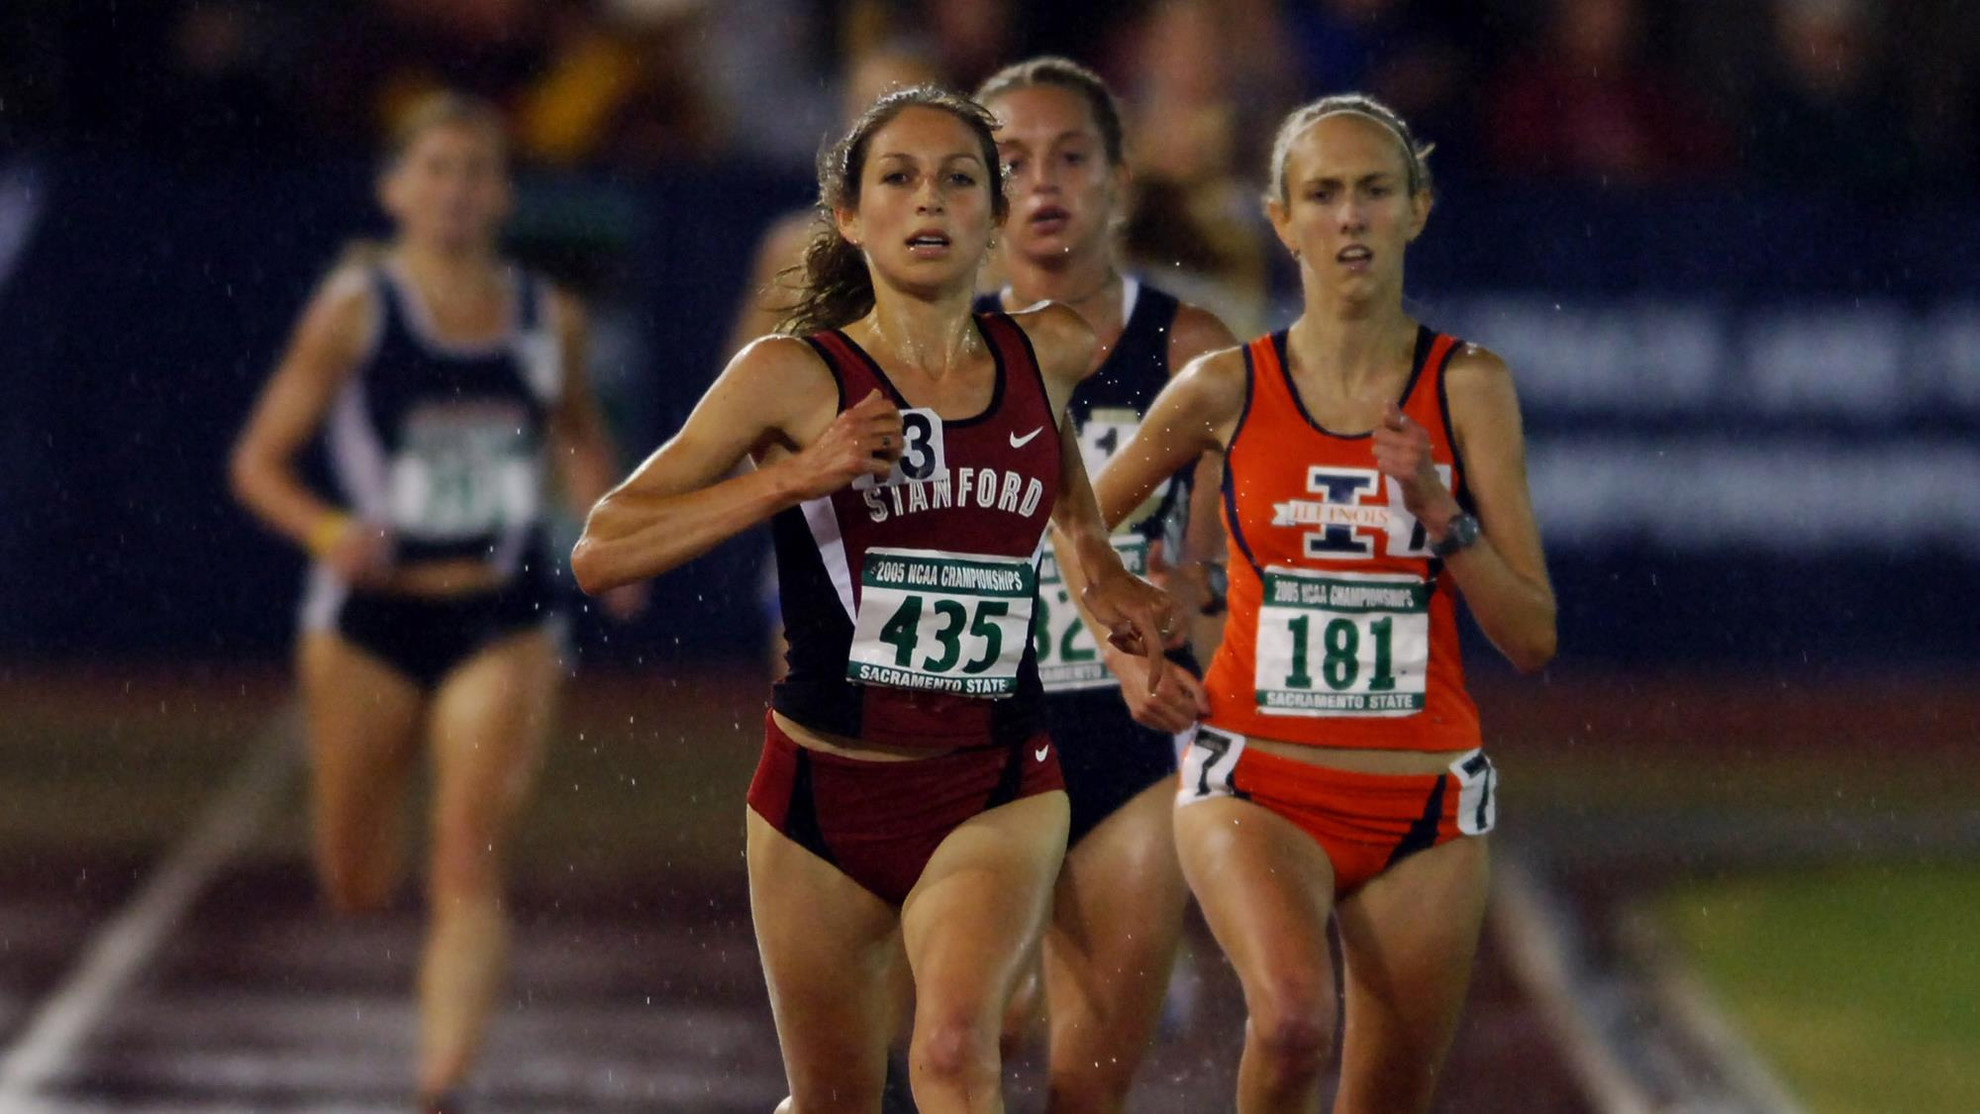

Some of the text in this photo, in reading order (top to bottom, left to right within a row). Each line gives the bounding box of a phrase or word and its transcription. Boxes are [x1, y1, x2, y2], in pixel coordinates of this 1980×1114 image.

[862, 467, 1043, 523] STANFORD
[1293, 502, 1390, 524] ILLINOIS
[876, 561, 905, 583] 2005
[907, 564, 938, 586] NCAA
[941, 565, 1023, 592] CHAMPIONSHIPS
[1274, 580, 1414, 608] 2005 NCAA CHAMPIONSHIPS
[879, 595, 1009, 675] 435
[1285, 613, 1396, 692] 181
[859, 664, 1008, 693] SACRAMENTO STATE
[1266, 691, 1413, 709] SACRAMENTO STATE
[1194, 729, 1232, 796] 7
[1461, 751, 1490, 831] 7
